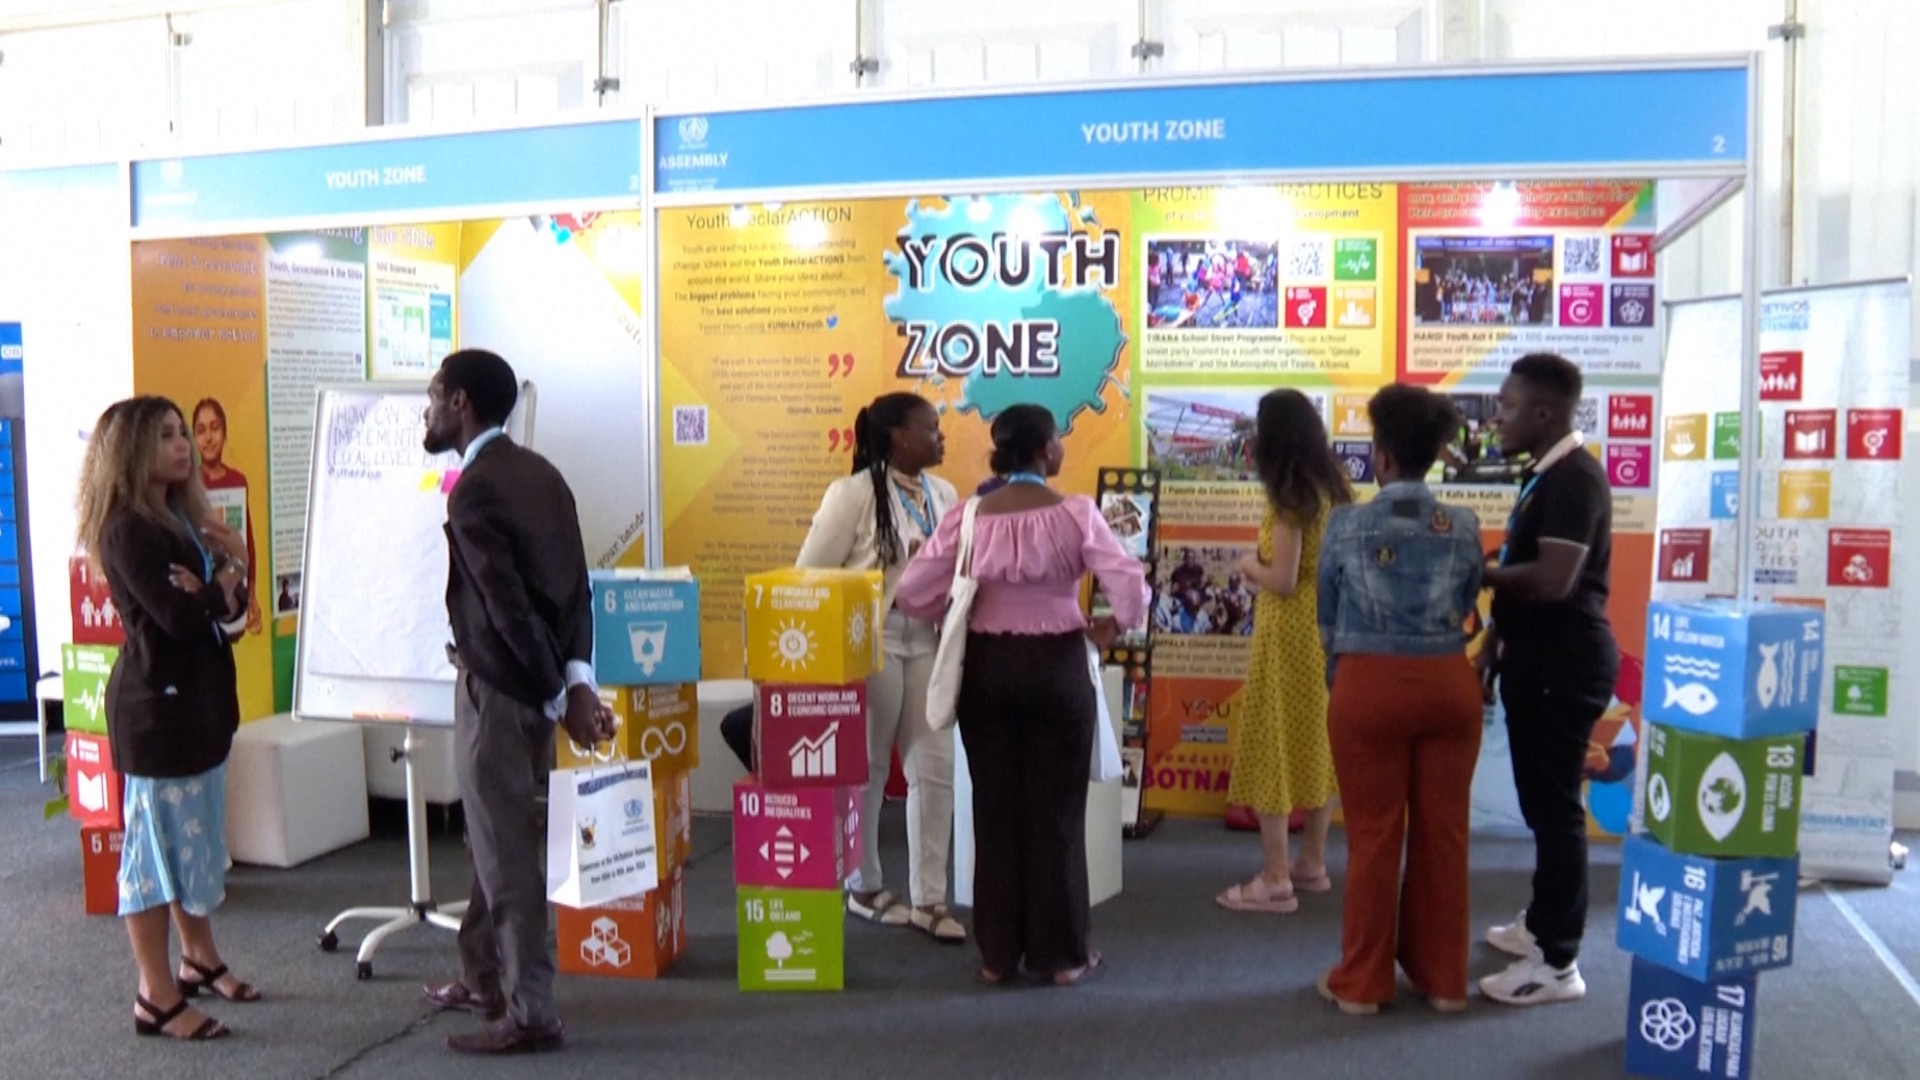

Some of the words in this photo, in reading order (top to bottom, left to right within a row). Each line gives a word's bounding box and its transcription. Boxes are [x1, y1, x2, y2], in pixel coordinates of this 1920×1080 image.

[1082, 121, 1158, 142] YOUTH
[1165, 119, 1225, 140] ZONE
[1713, 135, 1725, 153] 2
[658, 153, 728, 170] ASSEMBLY
[325, 169, 379, 189] YOUTH
[384, 165, 426, 186] ZONE
[687, 211, 730, 229] Youth
[738, 206, 852, 228] eclarATION
[269, 261, 290, 274] Youth,
[291, 262, 329, 276] Governance
[336, 267, 346, 278] the
[759, 257, 781, 267] Youth
[897, 230, 1119, 291] YOUTH
[690, 291, 718, 303] biggest
[720, 289, 756, 301] problems
[717, 306, 734, 316] best
[735, 306, 771, 316] solutions
[1147, 334, 1179, 343] TIRANA
[1182, 333, 1209, 343] School
[1211, 333, 1235, 343] Street
[1237, 333, 1282, 344] Programme
[1446, 333, 1470, 343] Youth
[1473, 333, 1486, 343] Act
[896, 319, 1061, 378] ZONE
[336, 405, 367, 425] HOW
[374, 404, 400, 426] CAN
[334, 426, 416, 448] IMPLEMENT
[332, 448, 367, 467] LOCAL
[374, 449, 415, 467] LEVEL
[79, 564, 87, 583] 1
[604, 588, 617, 614] 6
[624, 588, 648, 600] CLEAN
[649, 587, 674, 599] WATER
[754, 584, 764, 609] 7
[814, 586, 831, 599] AND
[624, 601, 641, 612] AND
[641, 600, 684, 612] SANITATION
[1652, 612, 1671, 640] 14
[1675, 616, 1690, 630] LIFE
[1803, 619, 1820, 642] 14
[1153, 640, 1185, 648] MPALA
[1220, 641, 1248, 649] School
[1674, 630, 1699, 645] BELOW
[1699, 633, 1726, 649] WATER
[632, 687, 646, 713] 12
[770, 693, 783, 717] 8
[787, 692, 817, 704] DECENT
[817, 691, 839, 703] WORK
[841, 690, 858, 702] AND
[787, 704, 827, 716] ECONOMIC
[827, 703, 861, 716] GROWTH
[1766, 744, 1796, 768] 13
[1144, 766, 1230, 791] BOTNA
[740, 793, 760, 817] 10
[764, 793, 798, 806] REDUCED
[764, 806, 812, 820] INEQUALITIES
[1683, 866, 1707, 891] 16
[745, 898, 764, 923] 15
[769, 899, 784, 910] LIFE
[1772, 935, 1788, 961] 16
[1716, 984, 1745, 1008] 17
